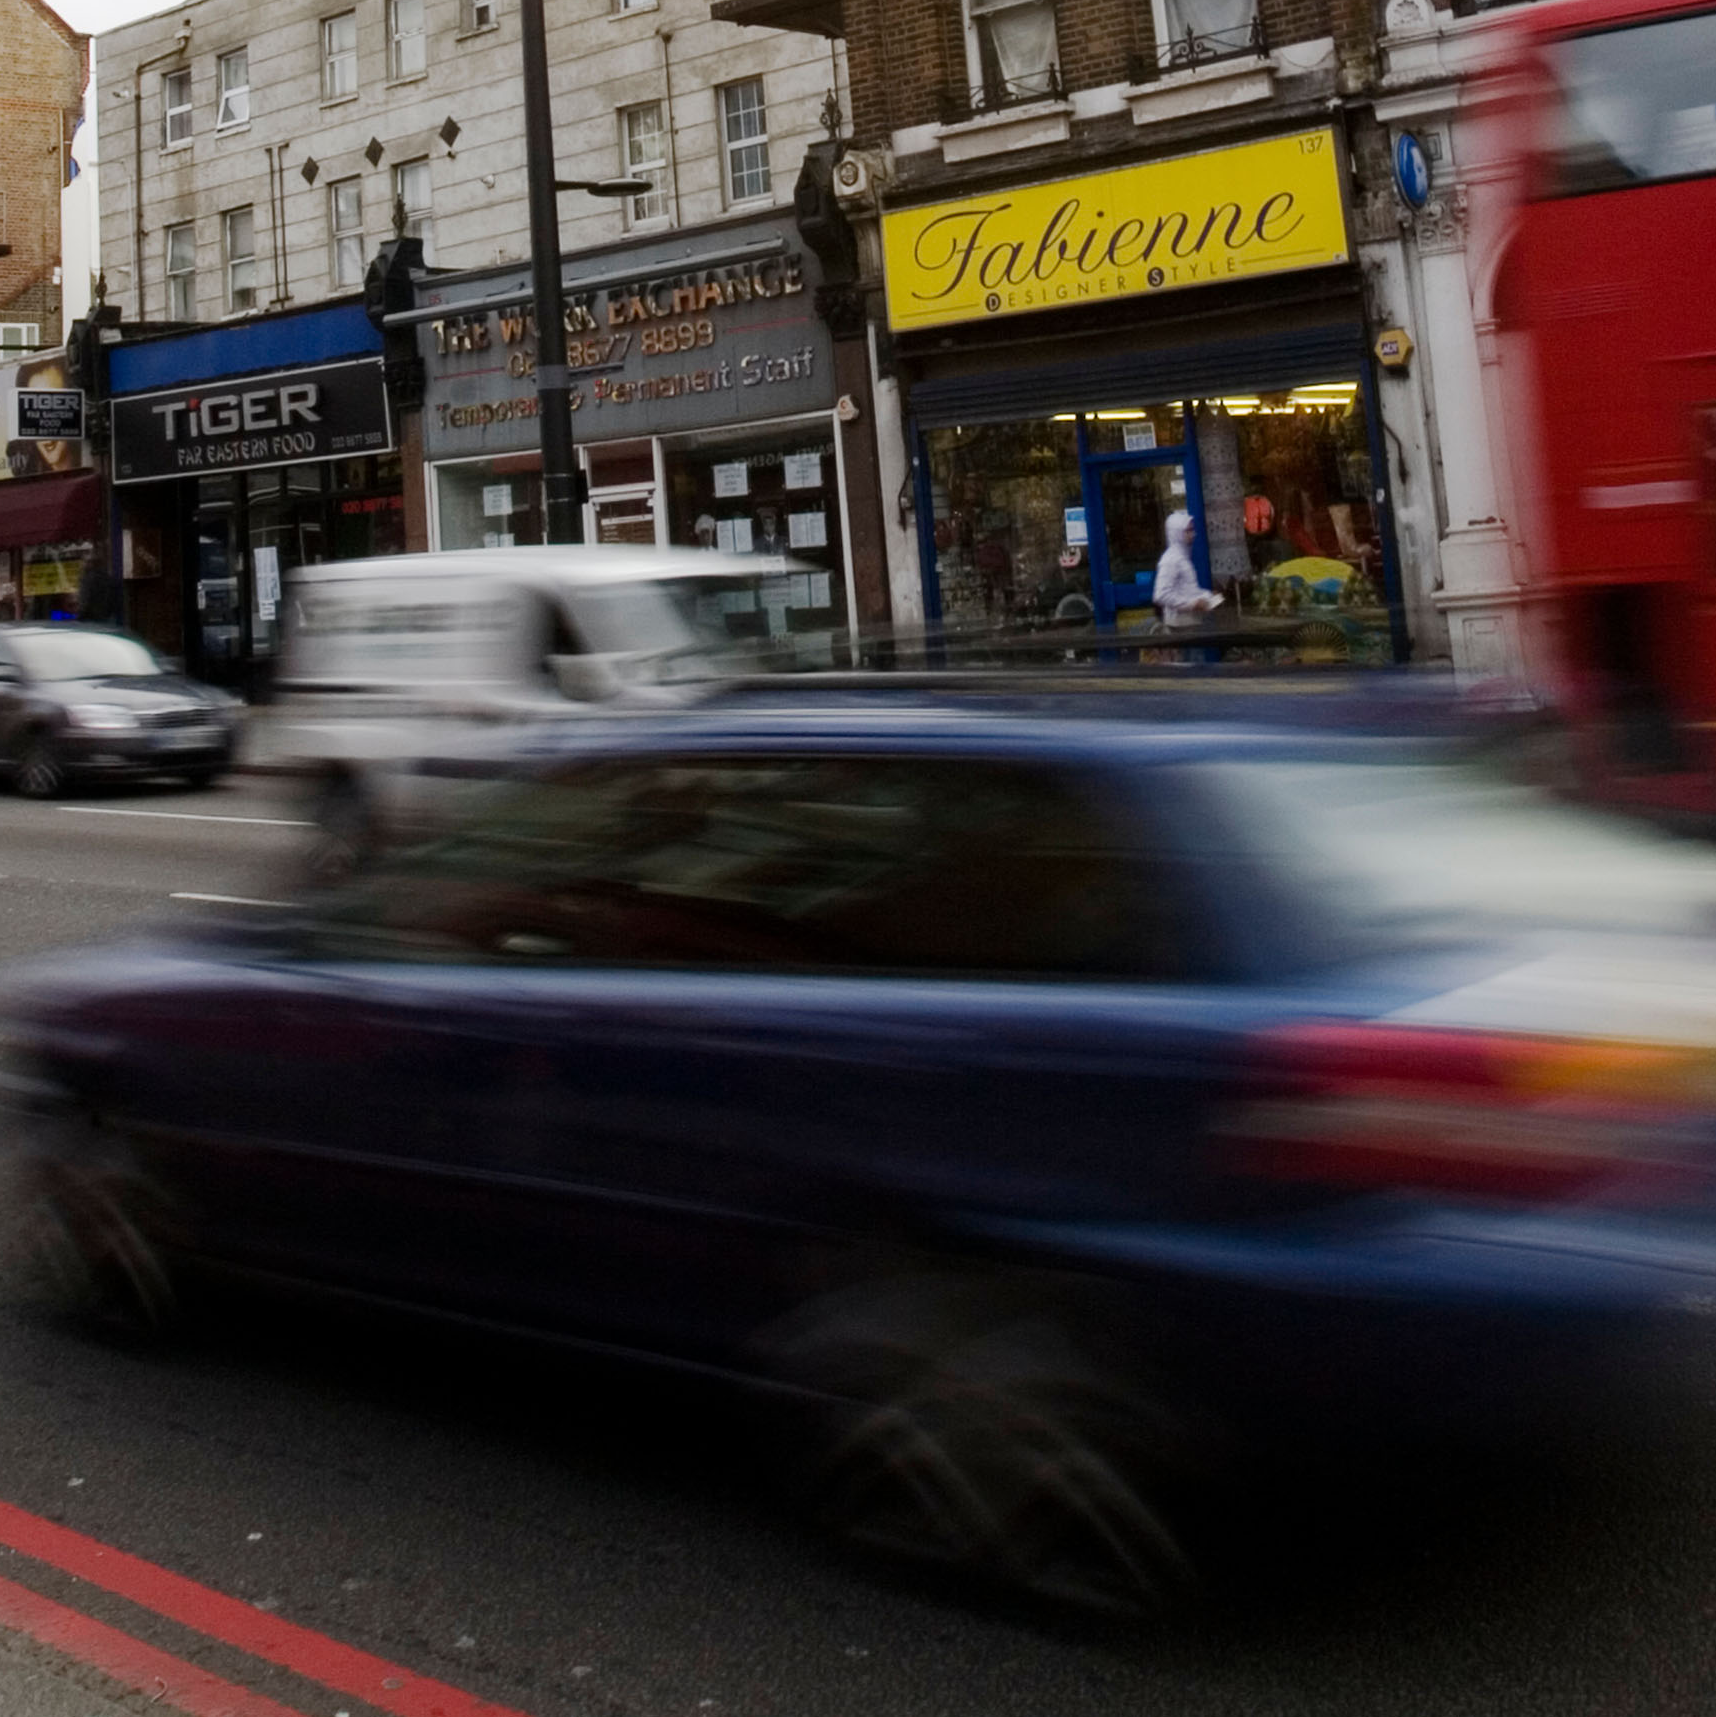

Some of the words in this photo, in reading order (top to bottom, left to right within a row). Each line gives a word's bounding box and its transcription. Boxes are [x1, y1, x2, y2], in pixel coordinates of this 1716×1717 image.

[1297, 136, 1324, 156] 137
[911, 191, 1305, 300] Fabienne
[431, 310, 489, 356] THE
[496, 290, 599, 346] WRK
[606, 251, 805, 327] EXCHANGE
[985, 276, 1127, 313] DESIGNER
[1147, 259, 1237, 288] STYLE
[640, 317, 715, 356] 8899
[19, 393, 80, 410] TIGER
[434, 395, 543, 430] Temporar
[593, 357, 733, 408] Permanent
[739, 344, 815, 387] Staff
[177, 446, 203, 467] FAR
[207, 437, 268, 464] EASTERN
[274, 432, 316, 456] FOOD
